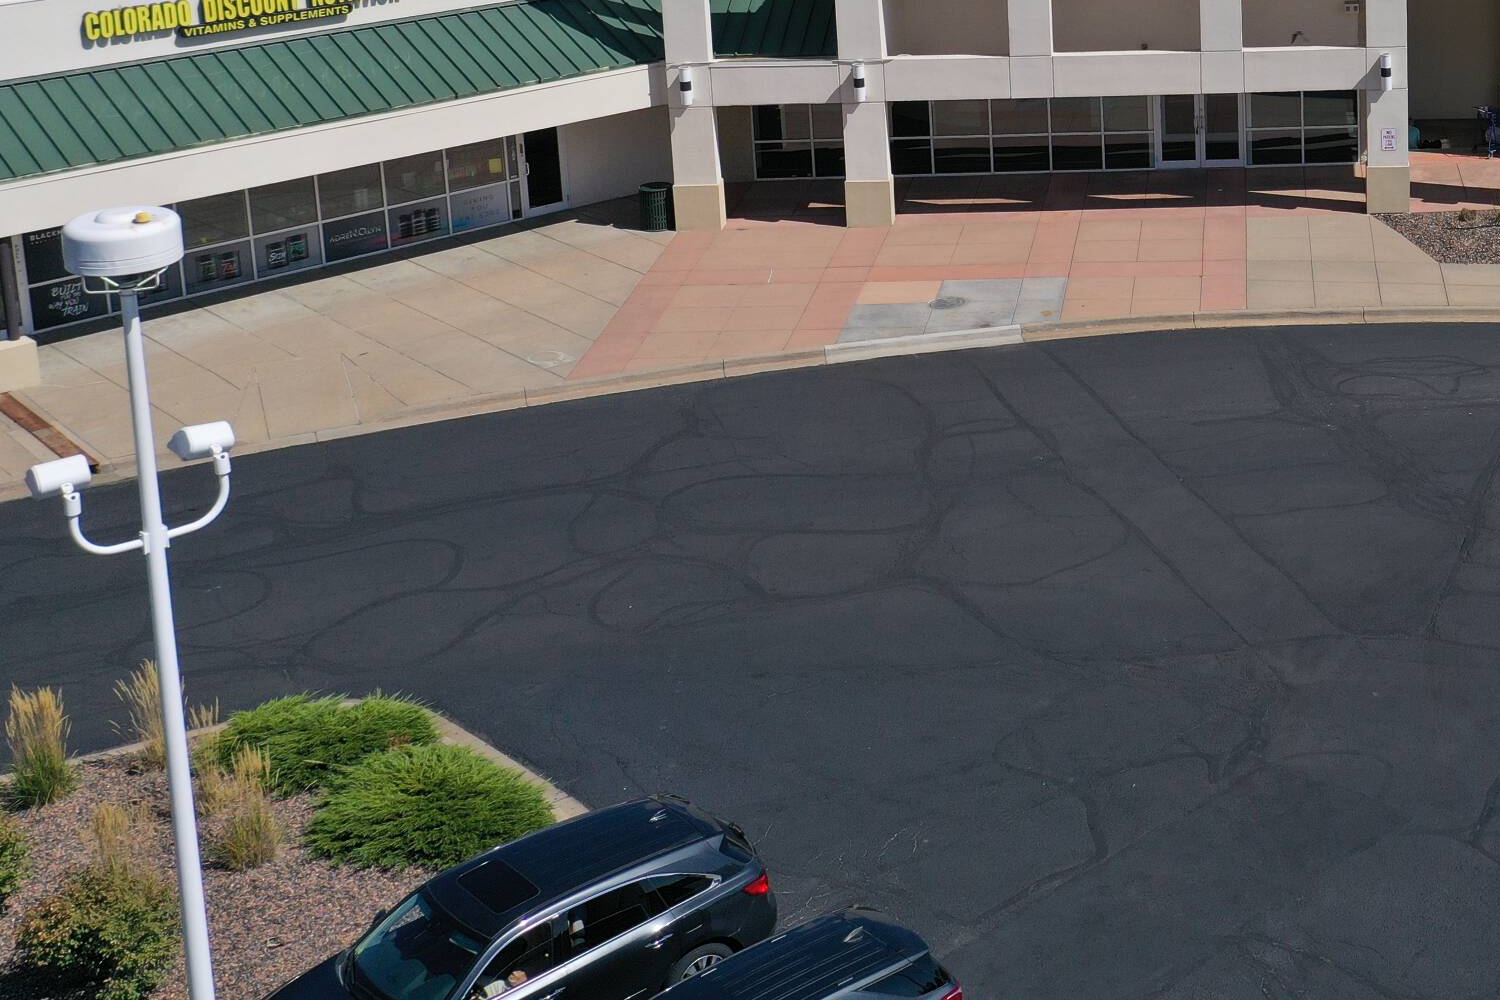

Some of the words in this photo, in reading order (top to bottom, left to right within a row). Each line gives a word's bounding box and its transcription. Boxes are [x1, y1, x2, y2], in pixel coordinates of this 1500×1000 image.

[84, 0, 192, 41] COLORADO
[184, 19, 246, 37] VITAMINS
[248, 17, 257, 28] &
[260, 4, 349, 26] SUPPLEMENTS
